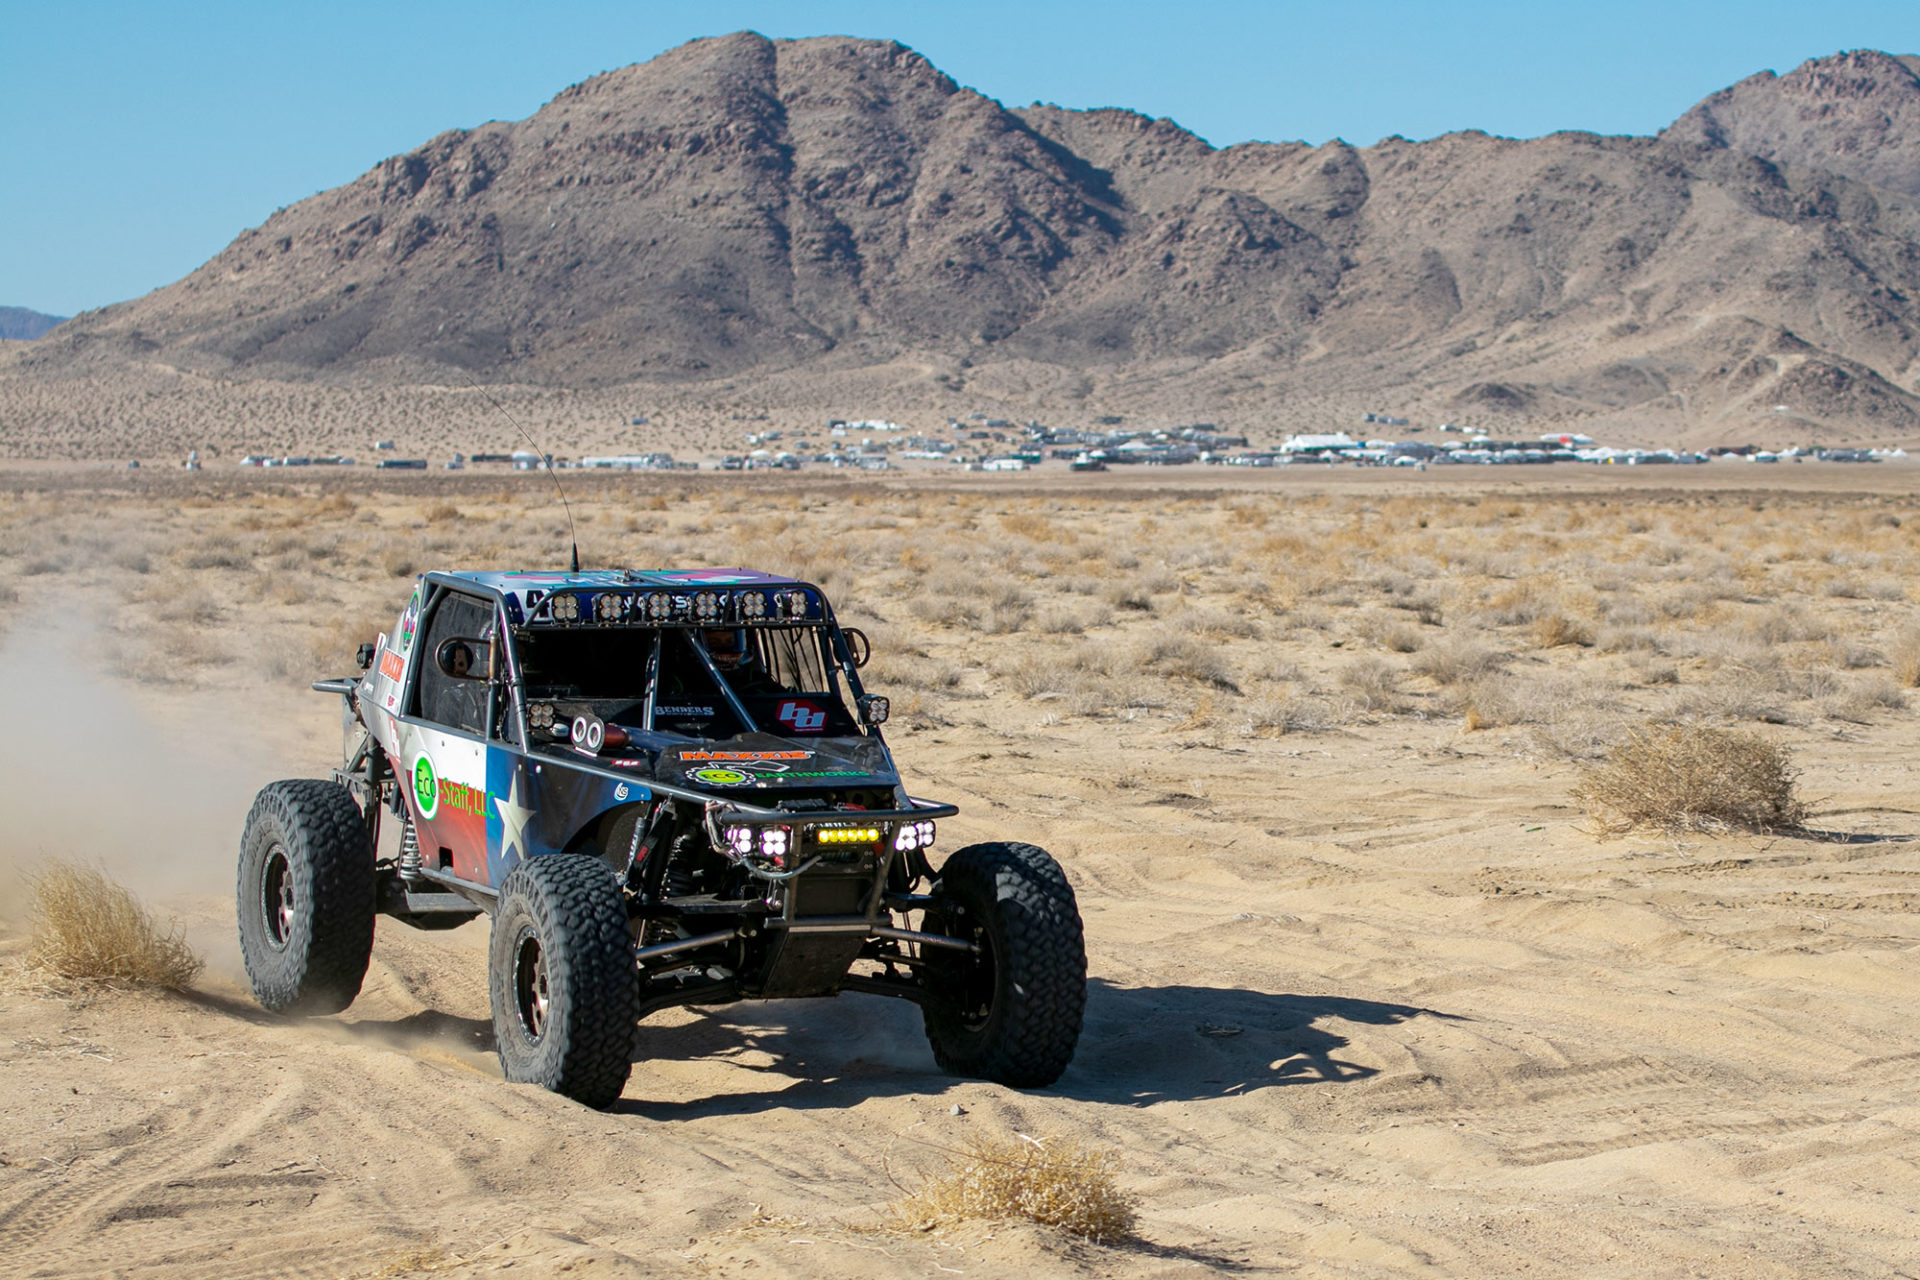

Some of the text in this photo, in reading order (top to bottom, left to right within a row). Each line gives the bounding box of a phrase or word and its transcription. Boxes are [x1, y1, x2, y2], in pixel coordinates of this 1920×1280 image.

[654, 706, 715, 716] BENDERS
[679, 750, 816, 761] MAXXIS
[701, 770, 871, 781] ECO EARTHWORKS
[474, 786, 496, 819] LLC
